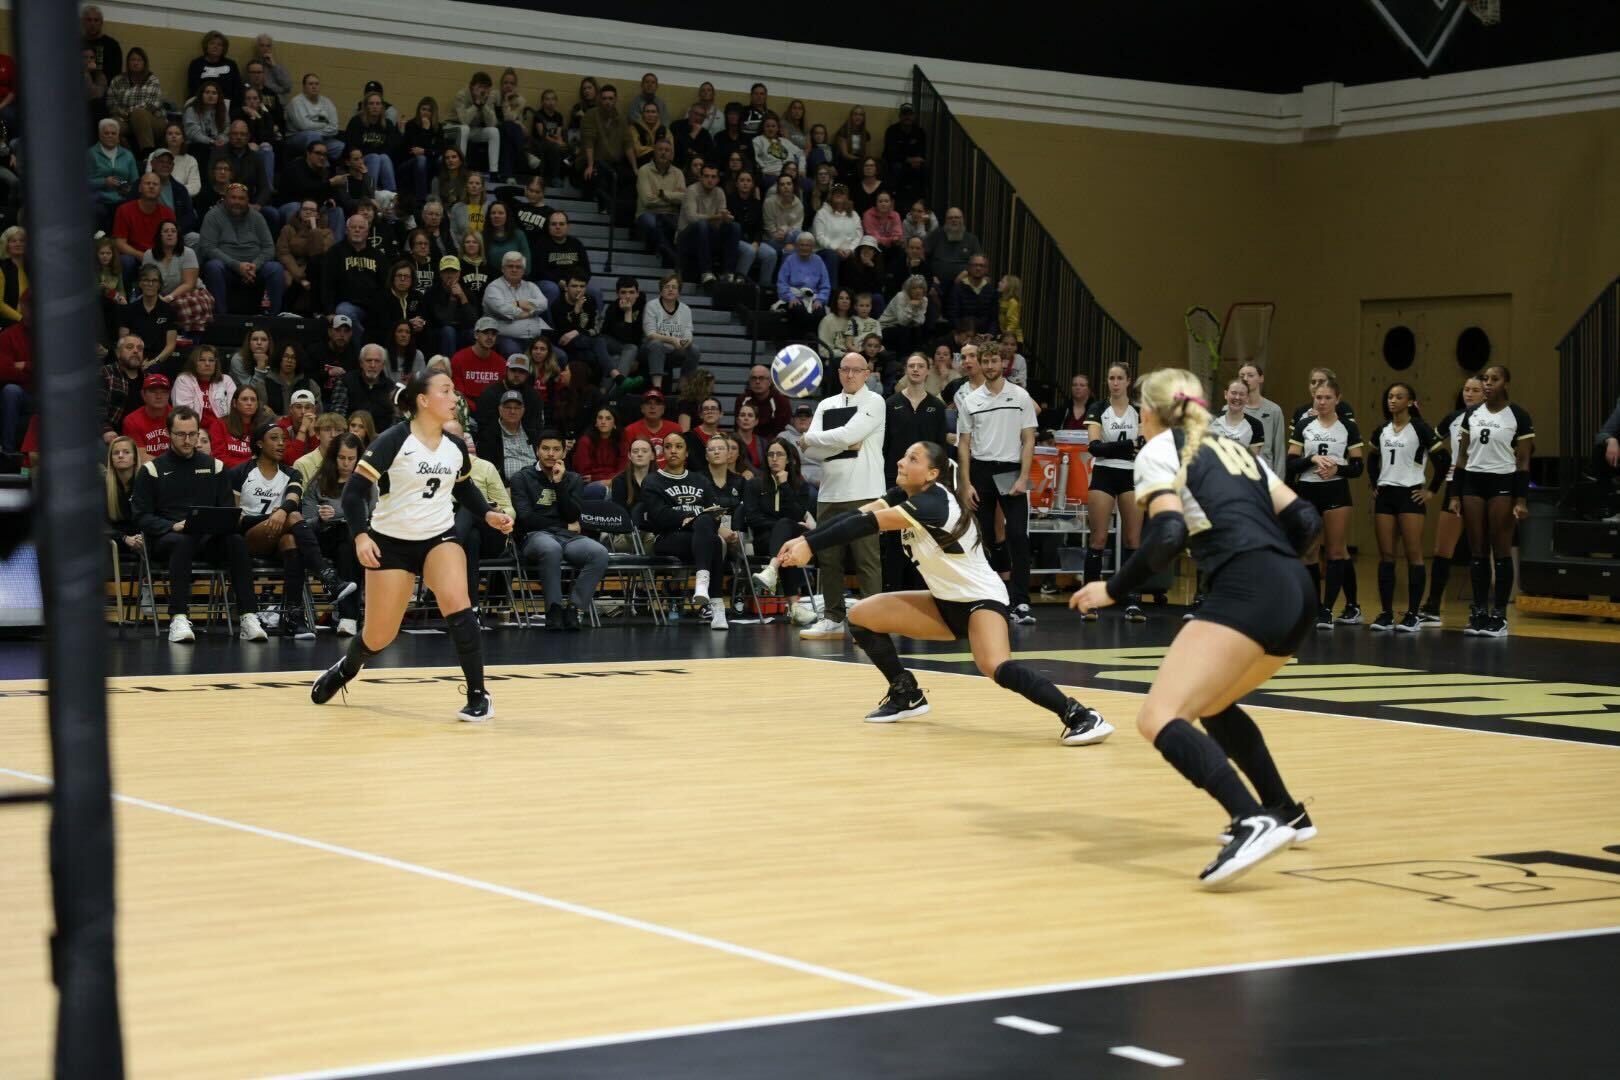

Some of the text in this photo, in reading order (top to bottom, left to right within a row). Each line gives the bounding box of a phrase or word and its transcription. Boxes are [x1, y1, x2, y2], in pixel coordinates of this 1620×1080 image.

[465, 370, 499, 381] RUTGERS
[1109, 422, 1133, 430] Boilers
[1311, 433, 1337, 442] Boilers
[1479, 428, 1491, 445] 8
[1318, 443, 1329, 456] 6
[1389, 449, 1396, 465] 1
[415, 462, 452, 475] Boilers
[422, 478, 441, 499] 3
[260, 498, 273, 515] 7
